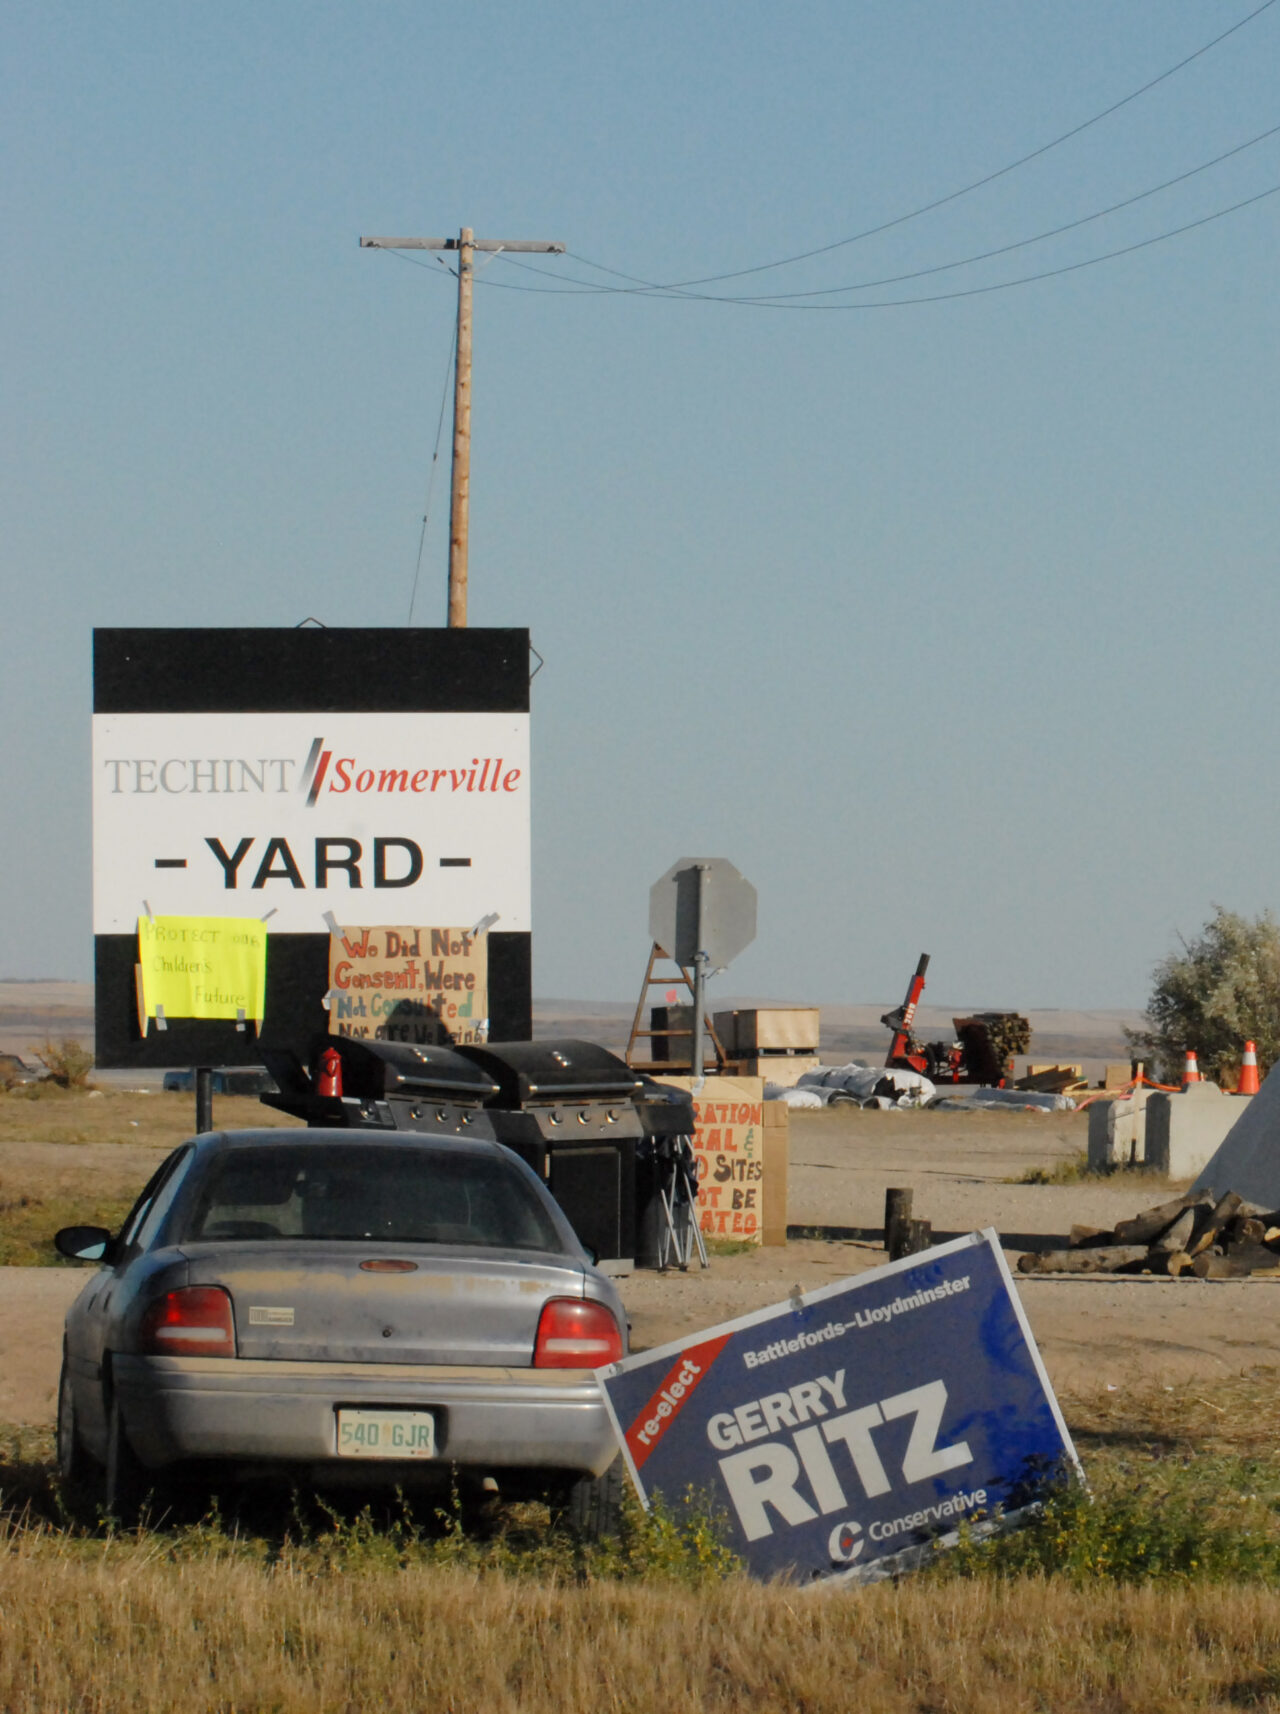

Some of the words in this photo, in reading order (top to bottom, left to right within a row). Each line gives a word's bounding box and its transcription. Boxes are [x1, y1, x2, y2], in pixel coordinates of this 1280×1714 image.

[104, 759, 296, 795] TECHINT
[329, 758, 521, 793] Somerville
[205, 837, 423, 889] YARD
[145, 922, 221, 944] PROTECT
[341, 930, 378, 958] We
[386, 929, 421, 958] Did
[431, 929, 472, 956] Not
[424, 960, 475, 990] Were
[195, 985, 245, 1007] Future
[337, 995, 366, 1018] Not
[371, 992, 473, 1017] Consulted
[731, 1188, 756, 1209] BE
[637, 1359, 701, 1445] re-elect
[706, 1368, 847, 1450] GERRY
[341, 1422, 379, 1446] 540
[392, 1423, 430, 1447] GJR
[718, 1379, 974, 1542] RITZ
[869, 1488, 987, 1541] Conservative
